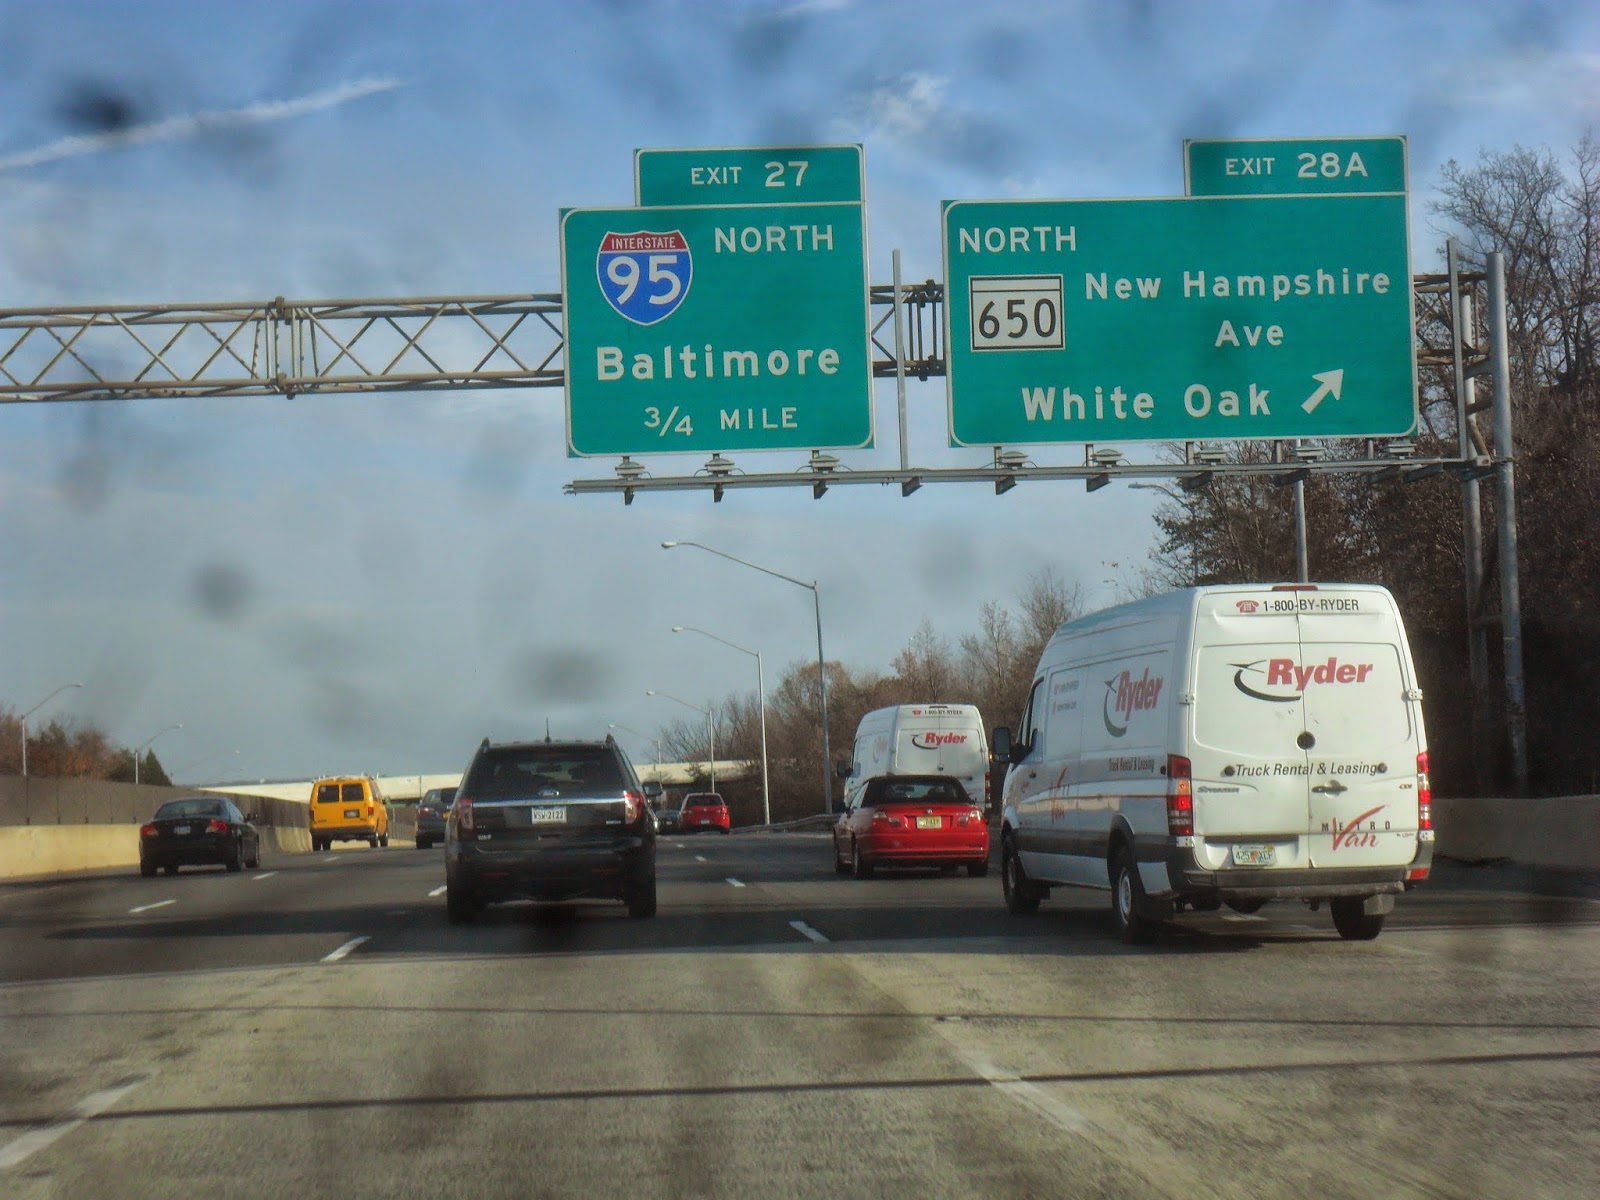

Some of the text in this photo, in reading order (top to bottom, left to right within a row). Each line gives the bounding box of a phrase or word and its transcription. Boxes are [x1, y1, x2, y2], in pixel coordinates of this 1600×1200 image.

[691, 160, 809, 188] EXIT 27
[1225, 151, 1369, 179] EXIT 28A
[611, 236, 676, 250] INTERSTATE
[714, 224, 833, 253] NORTH
[959, 225, 1077, 254] NORTH
[607, 254, 682, 305] 95
[1086, 267, 1391, 301] New Hampshire
[978, 298, 1057, 339] 650
[1214, 319, 1285, 347] Ave
[596, 343, 840, 381] Baltimore
[1021, 382, 1272, 421] White Oak
[644, 406, 798, 437] 3/4 MILE
[1263, 598, 1360, 612] 1-800-BY-RYDER
[1267, 657, 1374, 691] Ryder
[1115, 667, 1163, 721] Ryder
[925, 731, 967, 746] Ryder
[1236, 761, 1378, 777] Truck Rental & Leasing
[1321, 820, 1391, 832] METRO
[1332, 804, 1387, 851] Van
